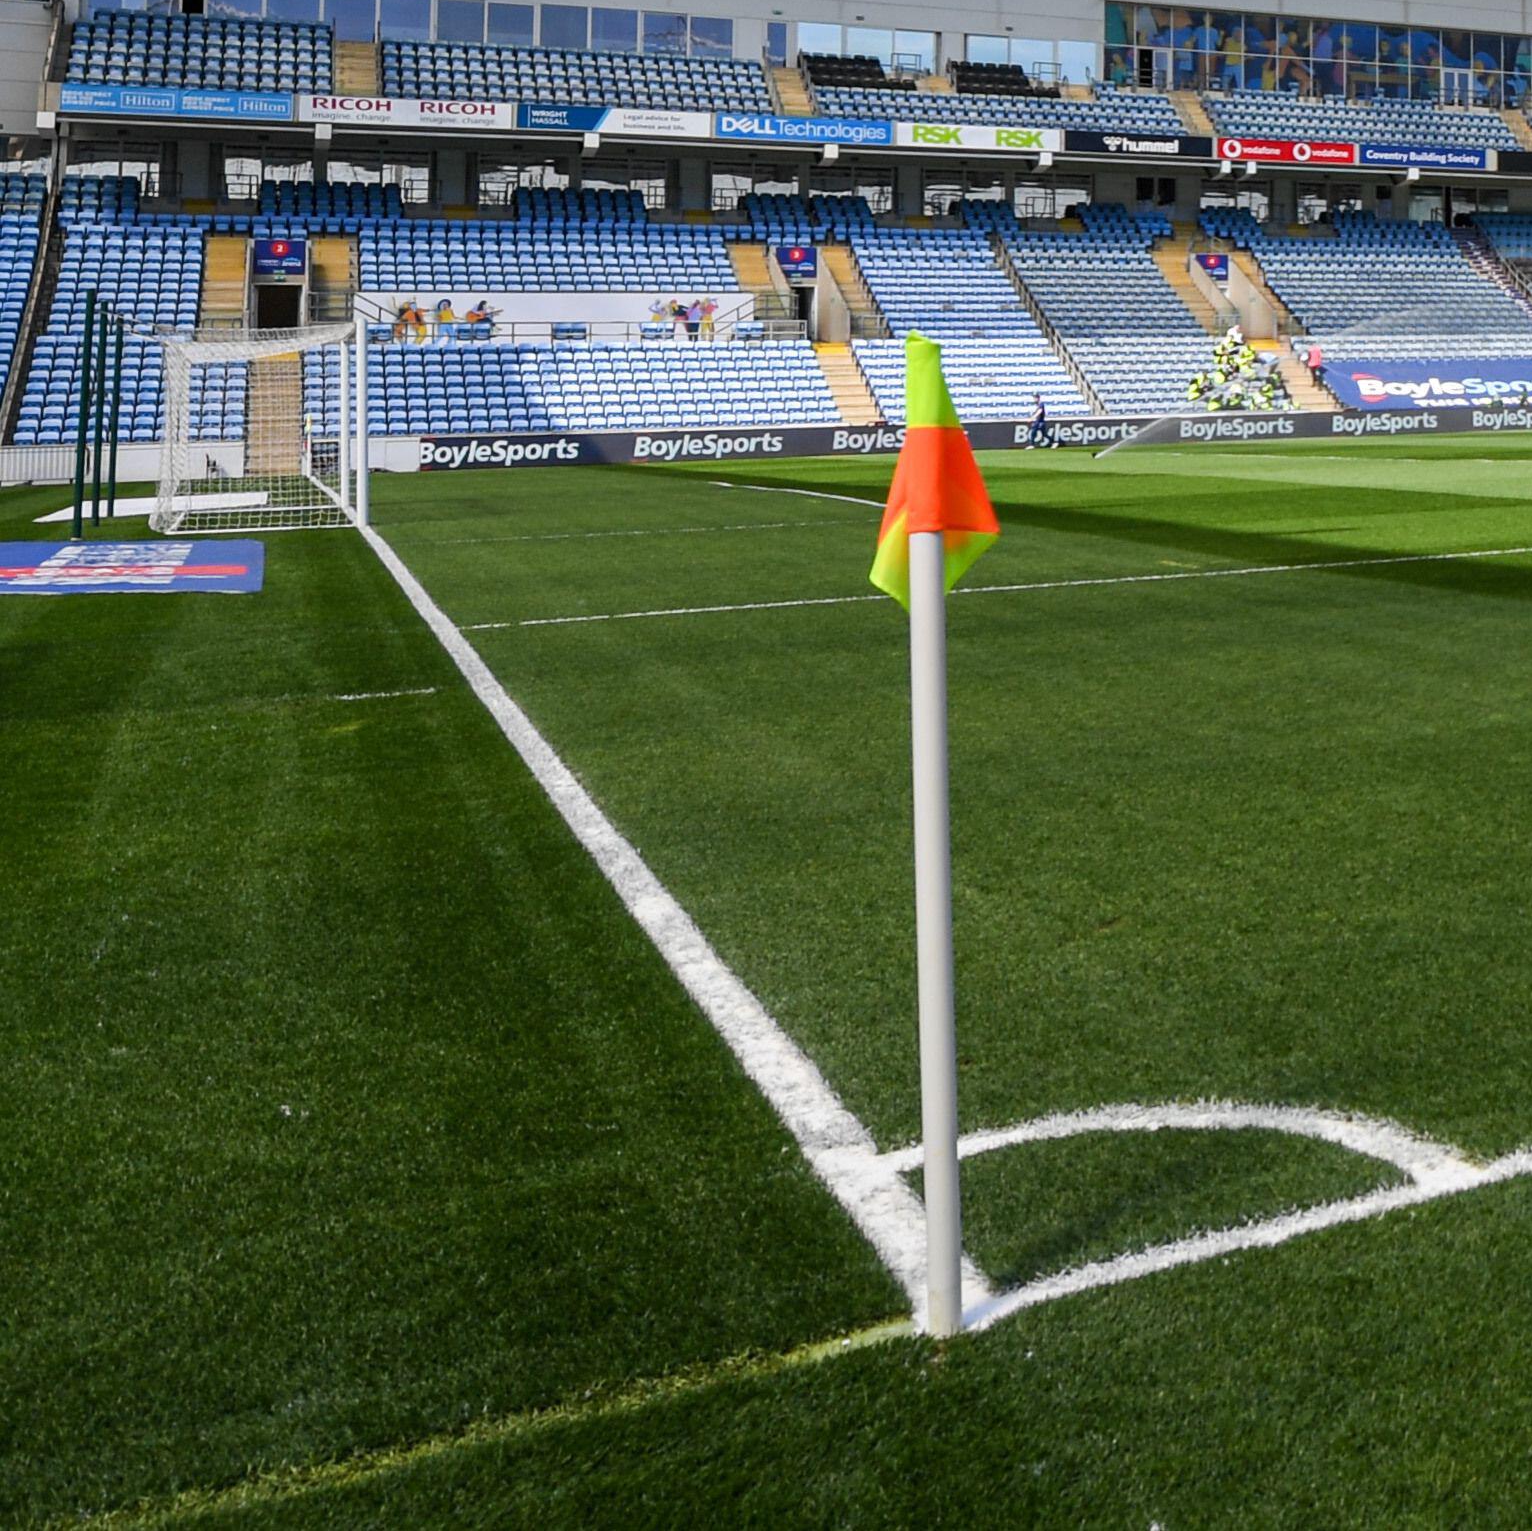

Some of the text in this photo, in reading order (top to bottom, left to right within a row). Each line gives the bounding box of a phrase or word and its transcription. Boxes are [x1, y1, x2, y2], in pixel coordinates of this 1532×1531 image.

[125, 95, 170, 108] Hilton
[243, 100, 287, 113] Hilton
[312, 97, 392, 112] RICOH
[420, 101, 496, 116] RICOH
[531, 109, 568, 118] WRIGHT
[531, 117, 569, 126] HASSALL
[721, 116, 887, 142] DELL Technologies
[912, 125, 963, 145] RSK
[996, 129, 1045, 149] RSK
[1122, 139, 1179, 154] hummel
[1243, 146, 1281, 156] vodafone
[1311, 149, 1349, 158] vodafone
[1366, 150, 1480, 166] Coventry Building Society
[1180, 416, 1294, 441] BoyleSports
[1332, 411, 1438, 436] BoyleSports
[634, 434, 783, 458] BoyleSports
[832, 427, 906, 453] BoyleS
[420, 439, 580, 467] BoyleSports
